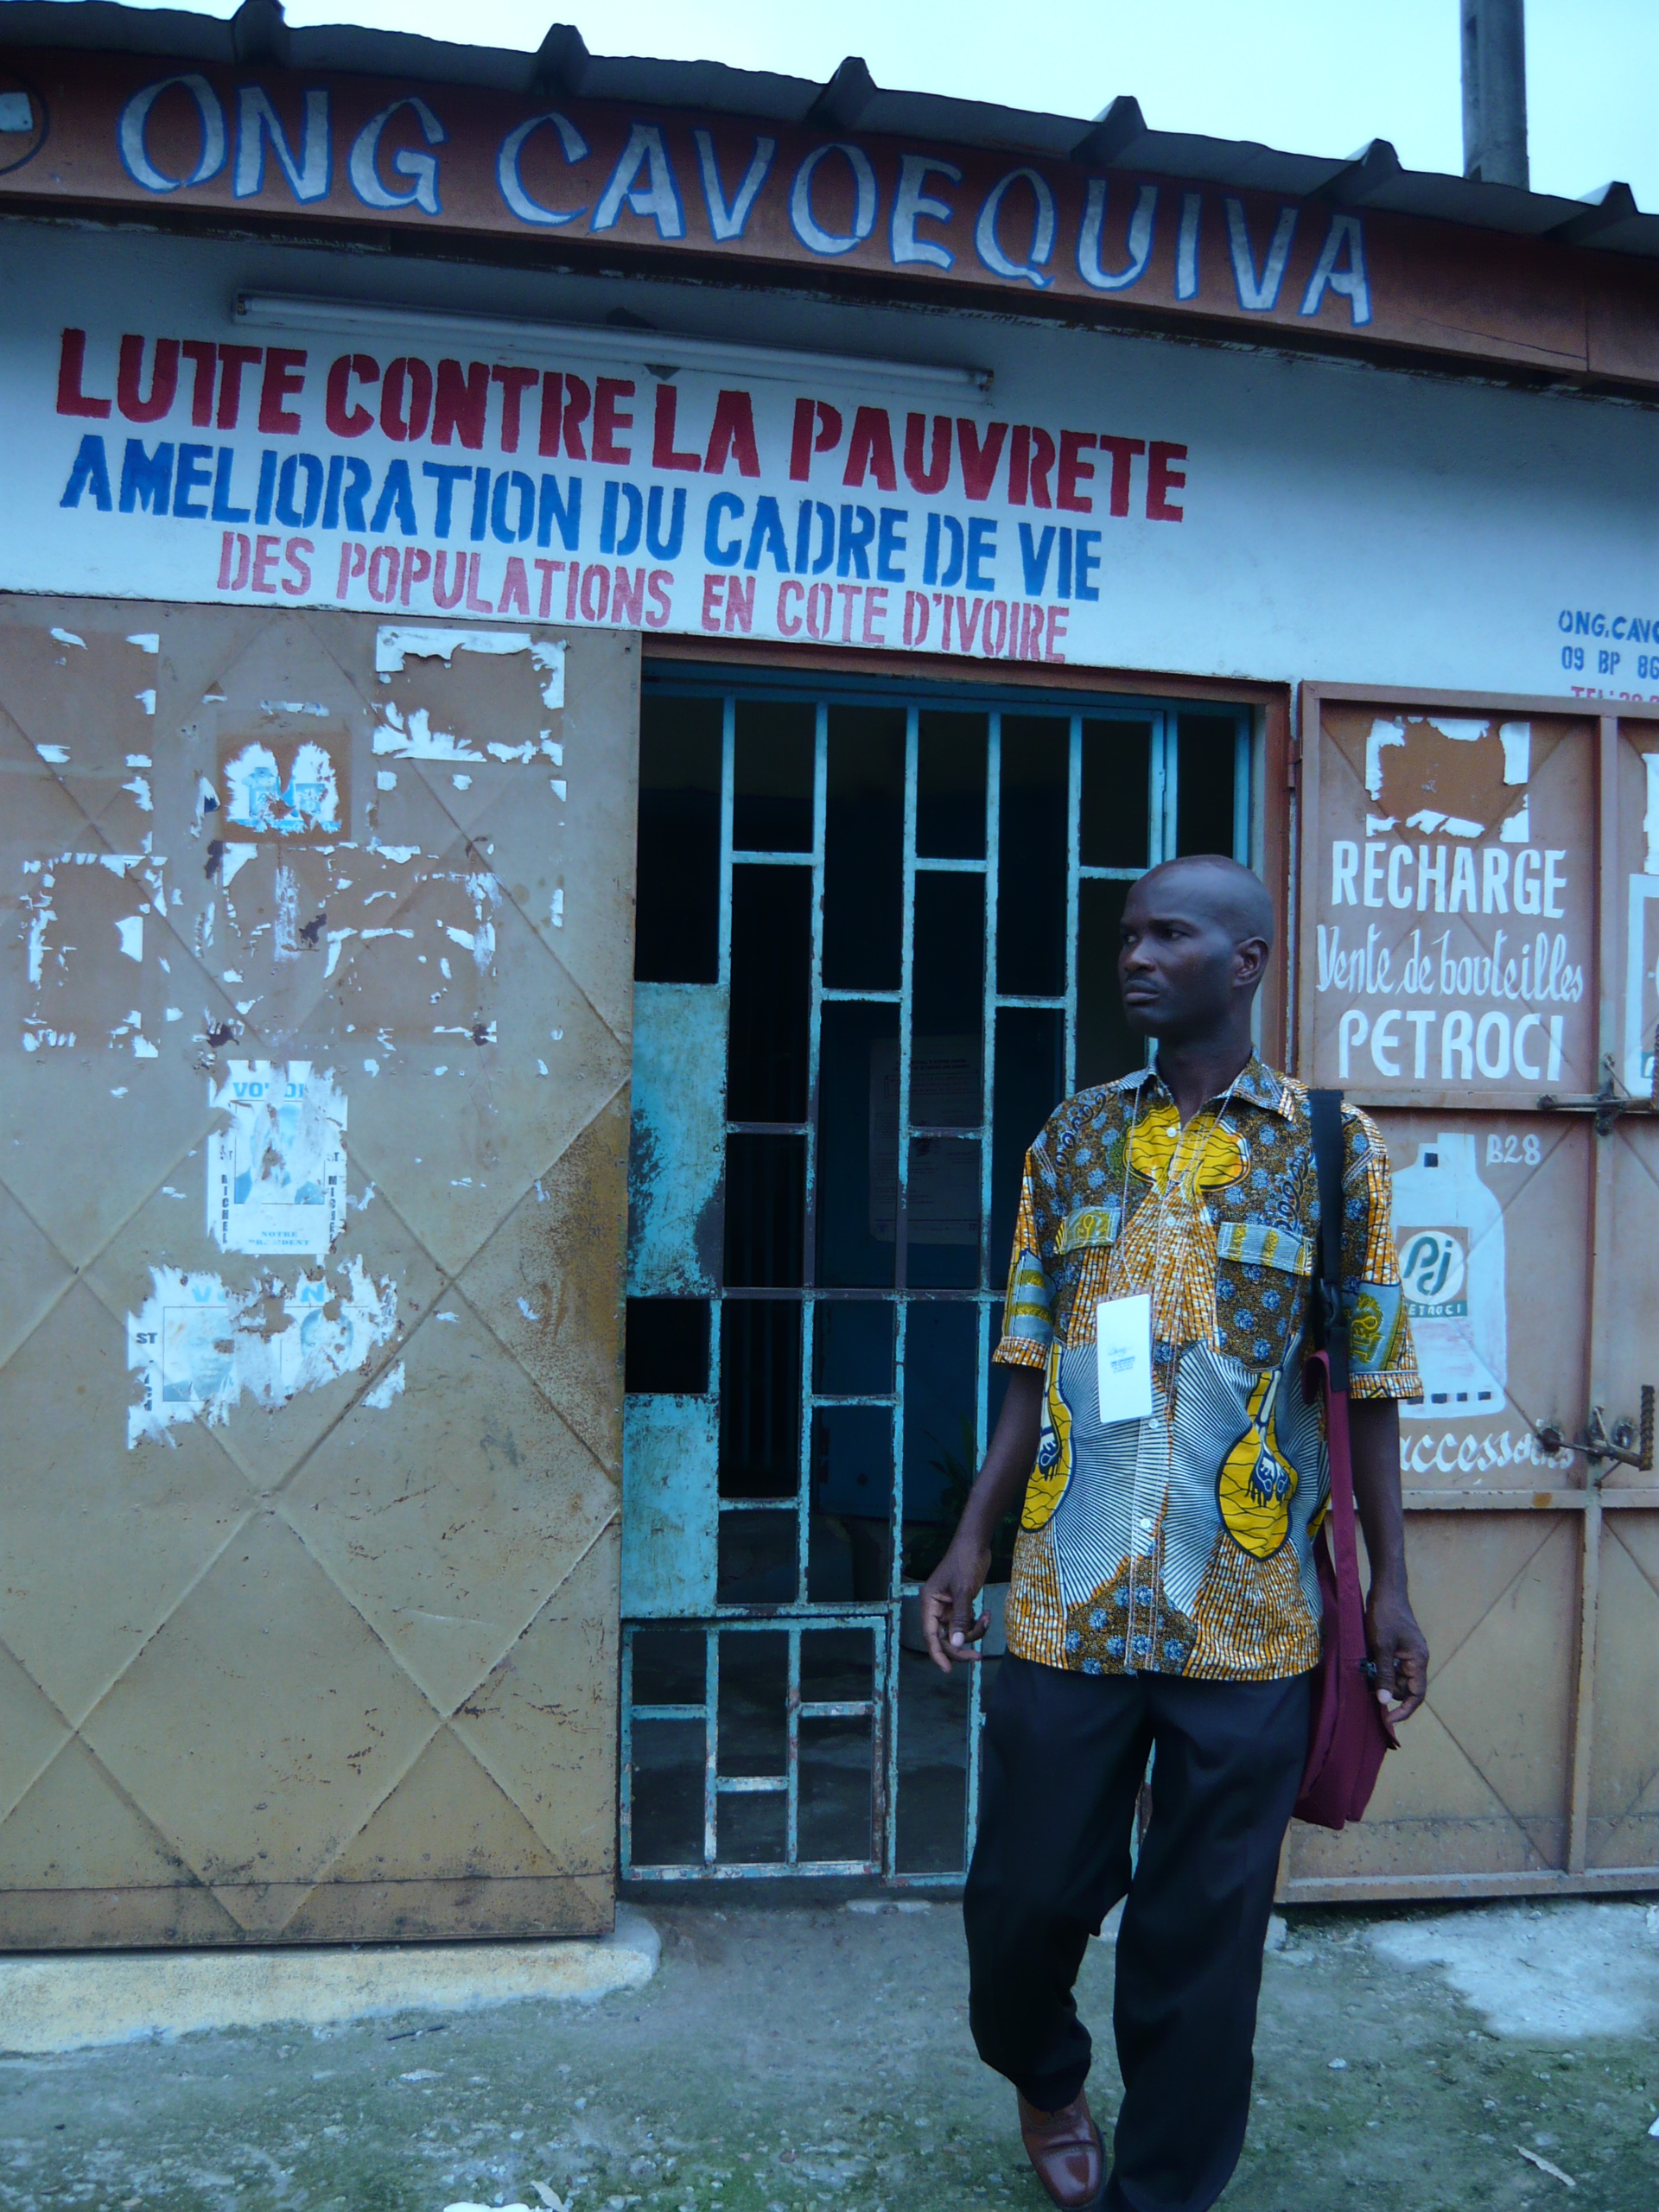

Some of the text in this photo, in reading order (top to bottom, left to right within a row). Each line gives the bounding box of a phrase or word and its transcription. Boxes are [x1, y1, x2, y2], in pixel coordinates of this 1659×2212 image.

[118, 73, 1372, 327] ONG CAVOEQUIVA
[56, 327, 1188, 523] LUTTE CONTRE LA PAUVRETE
[60, 435, 1102, 601] AMELIORATION DU CADRE DE VIE
[216, 531, 1070, 664] DES POPULATIONS EN COTE D'IVOIRE
[1561, 645, 1585, 671] 09
[1598, 650, 1621, 675] BP
[1332, 840, 1567, 918] RECHARGE
[1316, 923, 1584, 1002] Vente de bouteilles
[1338, 1009, 1563, 1081] PETROCI
[1485, 1134, 1541, 1166] B28
[137, 1332, 157, 1344] ST
[1404, 1303, 1461, 1316] ETROCI
